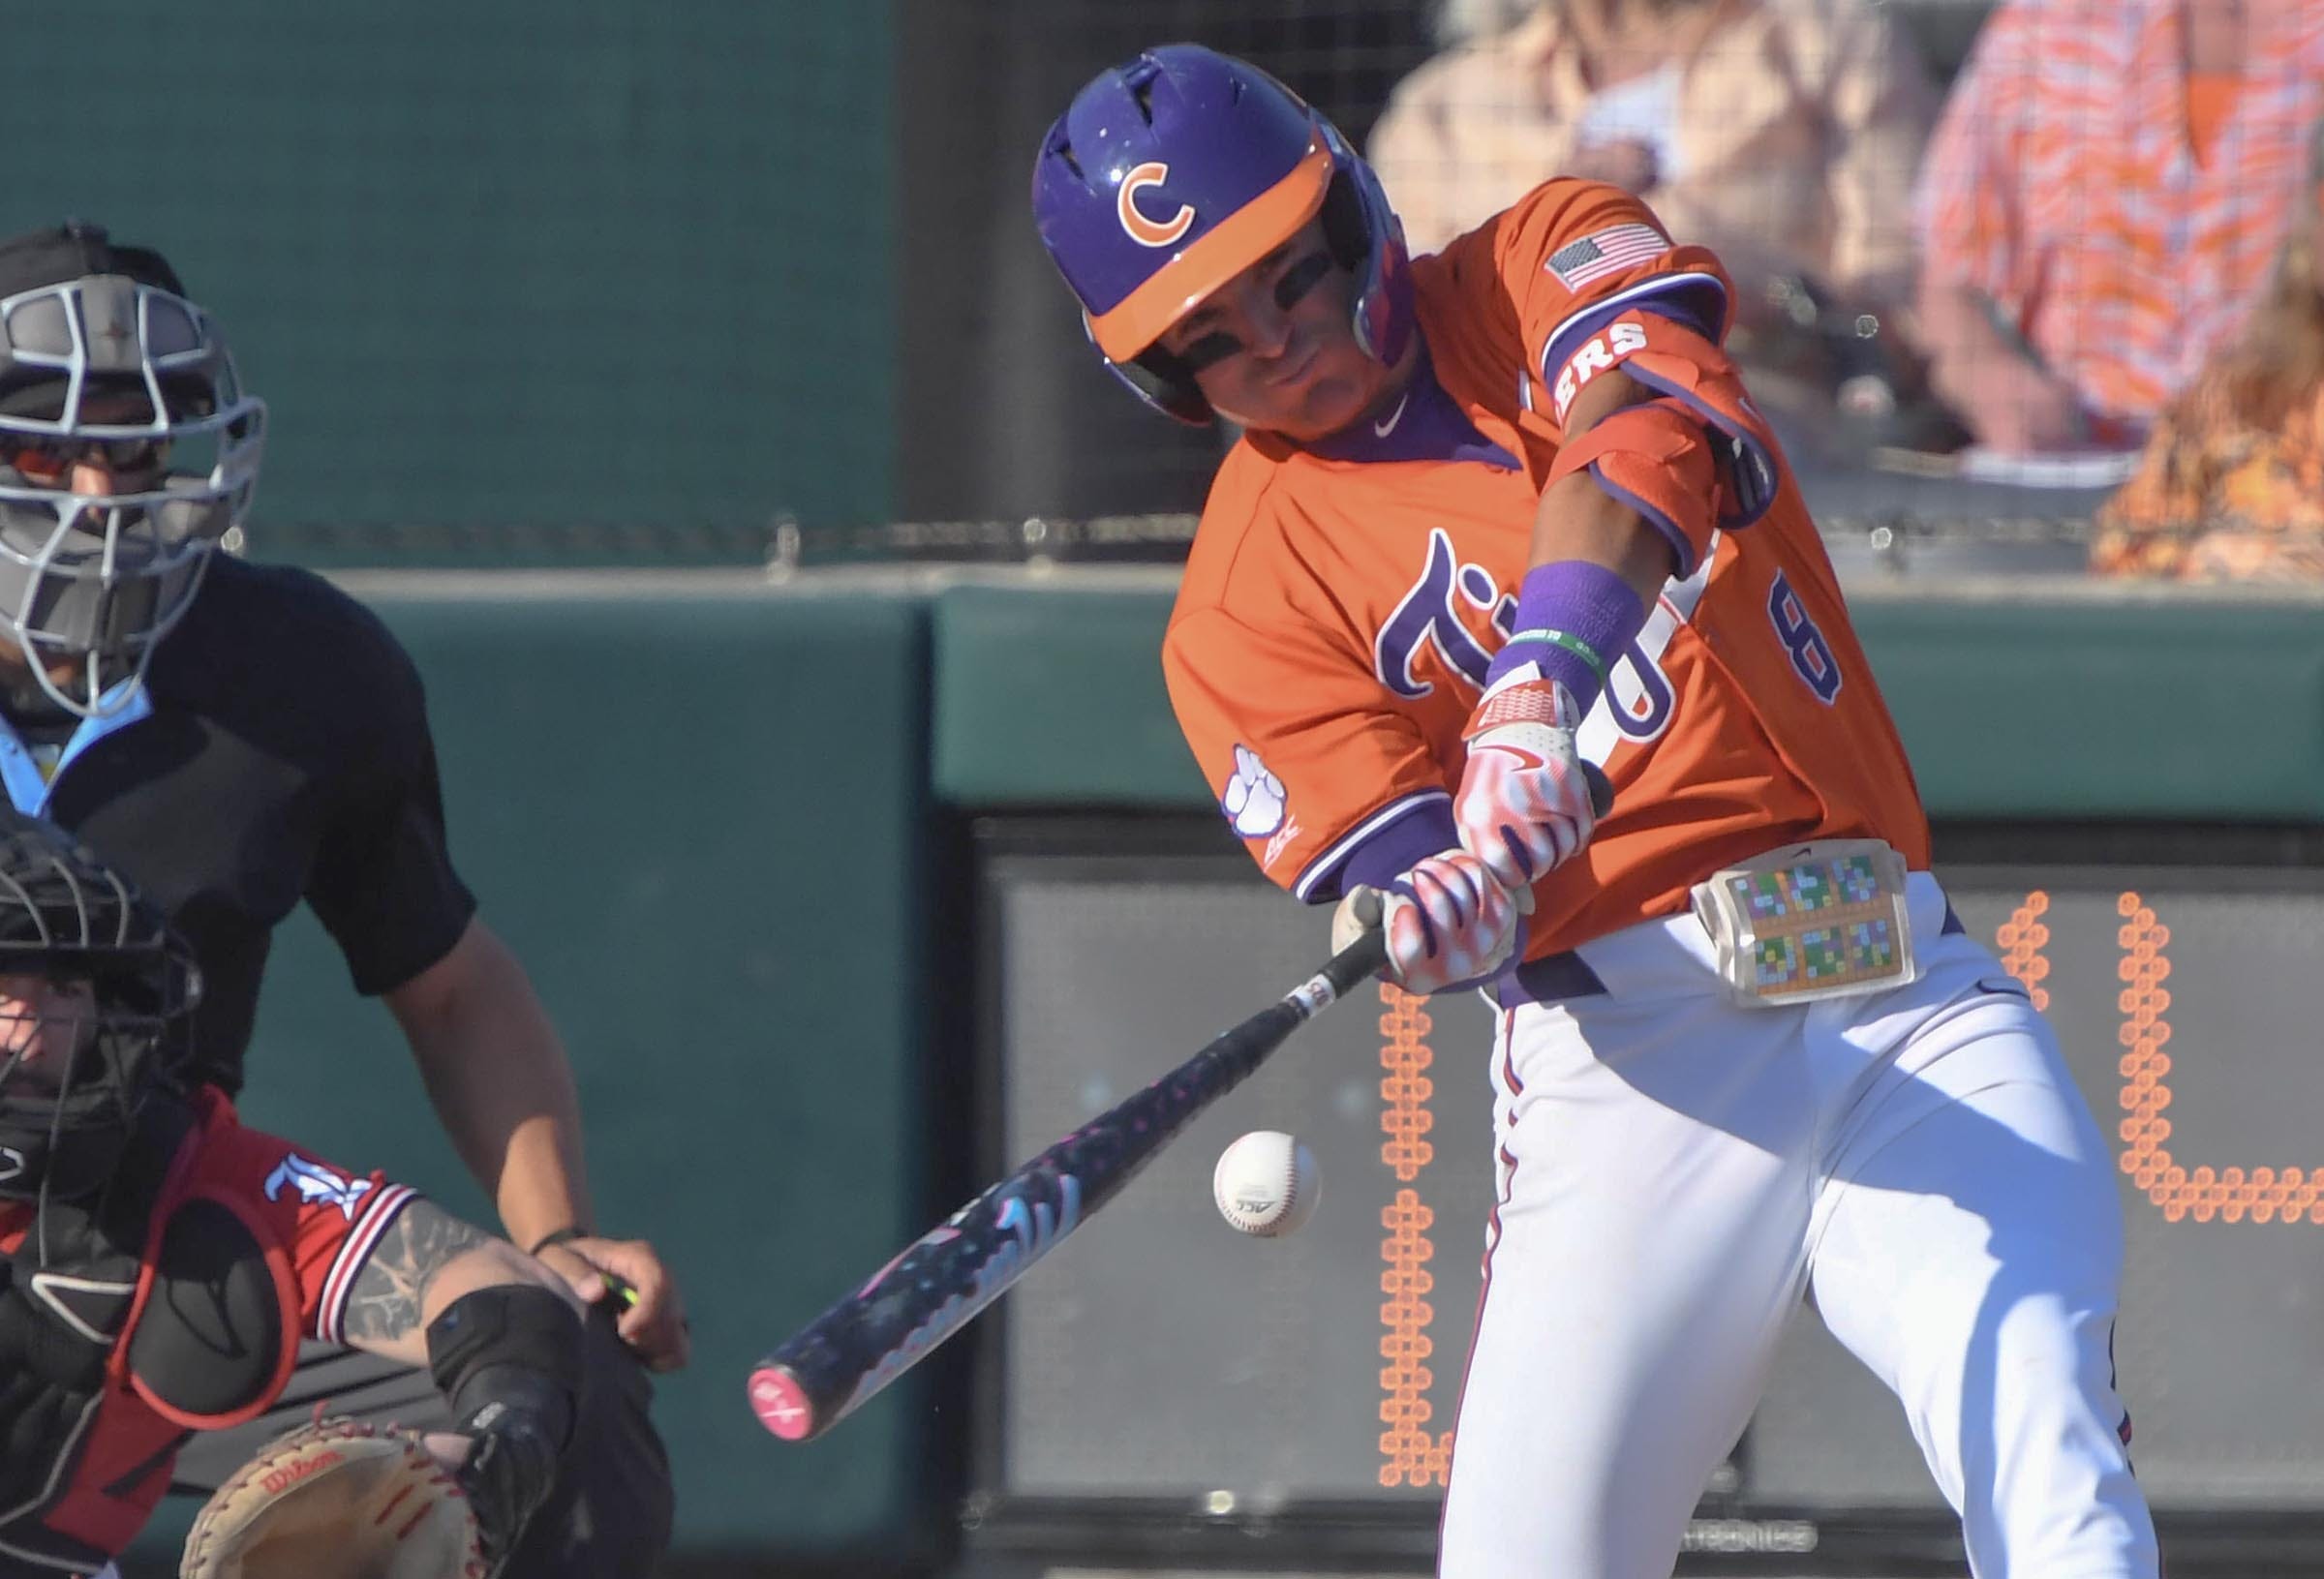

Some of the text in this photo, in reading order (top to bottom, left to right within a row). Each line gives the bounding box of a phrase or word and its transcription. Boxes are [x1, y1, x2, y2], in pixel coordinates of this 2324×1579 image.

[1117, 161, 1196, 248] C
[1554, 322, 1648, 422] ERS
[1766, 566, 1843, 708] 8
